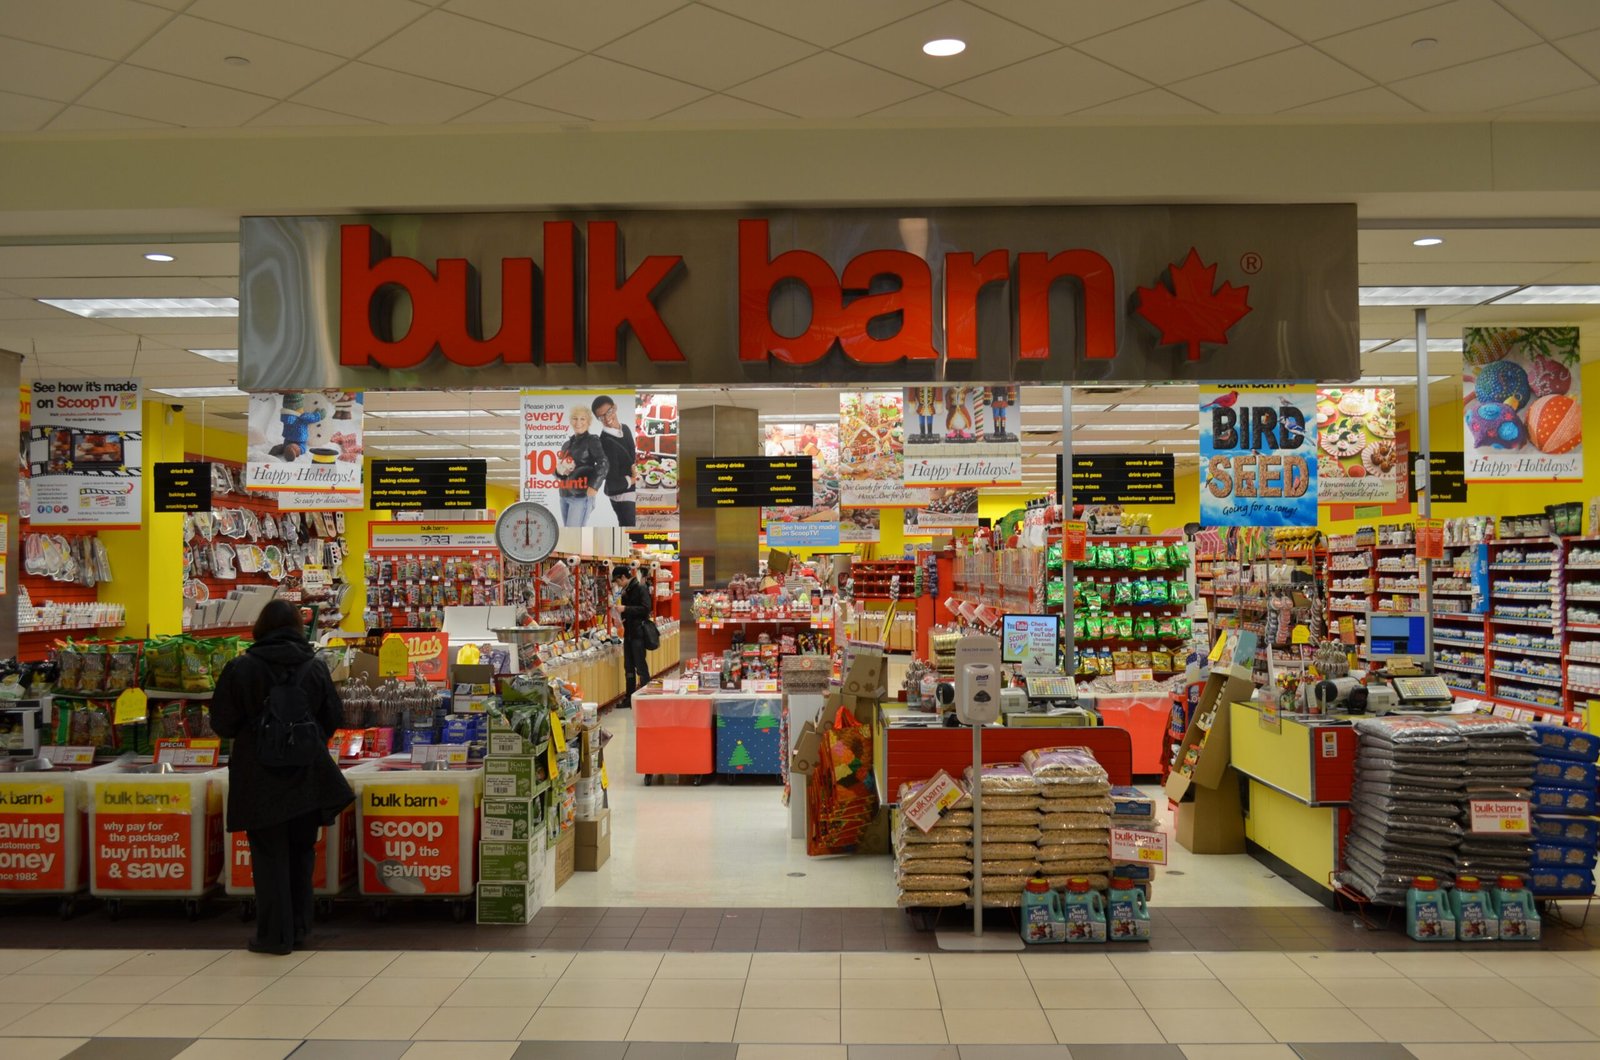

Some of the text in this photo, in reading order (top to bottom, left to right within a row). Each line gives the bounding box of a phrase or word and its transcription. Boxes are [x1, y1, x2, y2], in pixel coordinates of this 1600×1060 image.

[340, 219, 1116, 367] bulk barn
[33, 381, 138, 392] See how it's made
[36, 399, 54, 409] on
[56, 396, 118, 410] ScoopTV
[525, 412, 564, 424] every
[525, 424, 570, 432] Wednesday
[1212, 406, 1306, 450] BIRD
[525, 450, 573, 476] 10%
[1472, 459, 1574, 476] Happy Holidays!
[254, 467, 353, 485] Happy Holidays!
[911, 462, 1014, 480] Happy Holidays!
[1208, 455, 1310, 498] SEED
[525, 477, 588, 489] discount!
[854, 484, 872, 492] Candy
[873, 483, 881, 492] for
[1320, 480, 1367, 490] Homemade by
[636, 494, 664, 502] Fondant
[1340, 489, 1366, 500] Sprinkle
[1366, 489, 1374, 500] of
[302, 498, 314, 507] easy
[324, 496, 348, 504] delicious
[1222, 504, 1248, 516] Going
[1248, 501, 1263, 516] for
[1273, 505, 1298, 518] song!
[1009, 634, 1026, 643] SCOOP
[10, 792, 43, 804] barn
[104, 792, 170, 804] bulk barn
[371, 794, 438, 808] bulk barn
[909, 800, 926, 816] bulk
[923, 784, 943, 802] barn
[1474, 804, 1516, 812] bulk barn
[104, 822, 163, 832] why pay for
[370, 821, 443, 841] scoop
[110, 832, 180, 844] the package?
[1114, 832, 1154, 842] bulk barn
[102, 845, 186, 862] buy in bulk
[386, 842, 439, 860] up the
[108, 862, 185, 878] & save
[382, 862, 452, 880] savings
